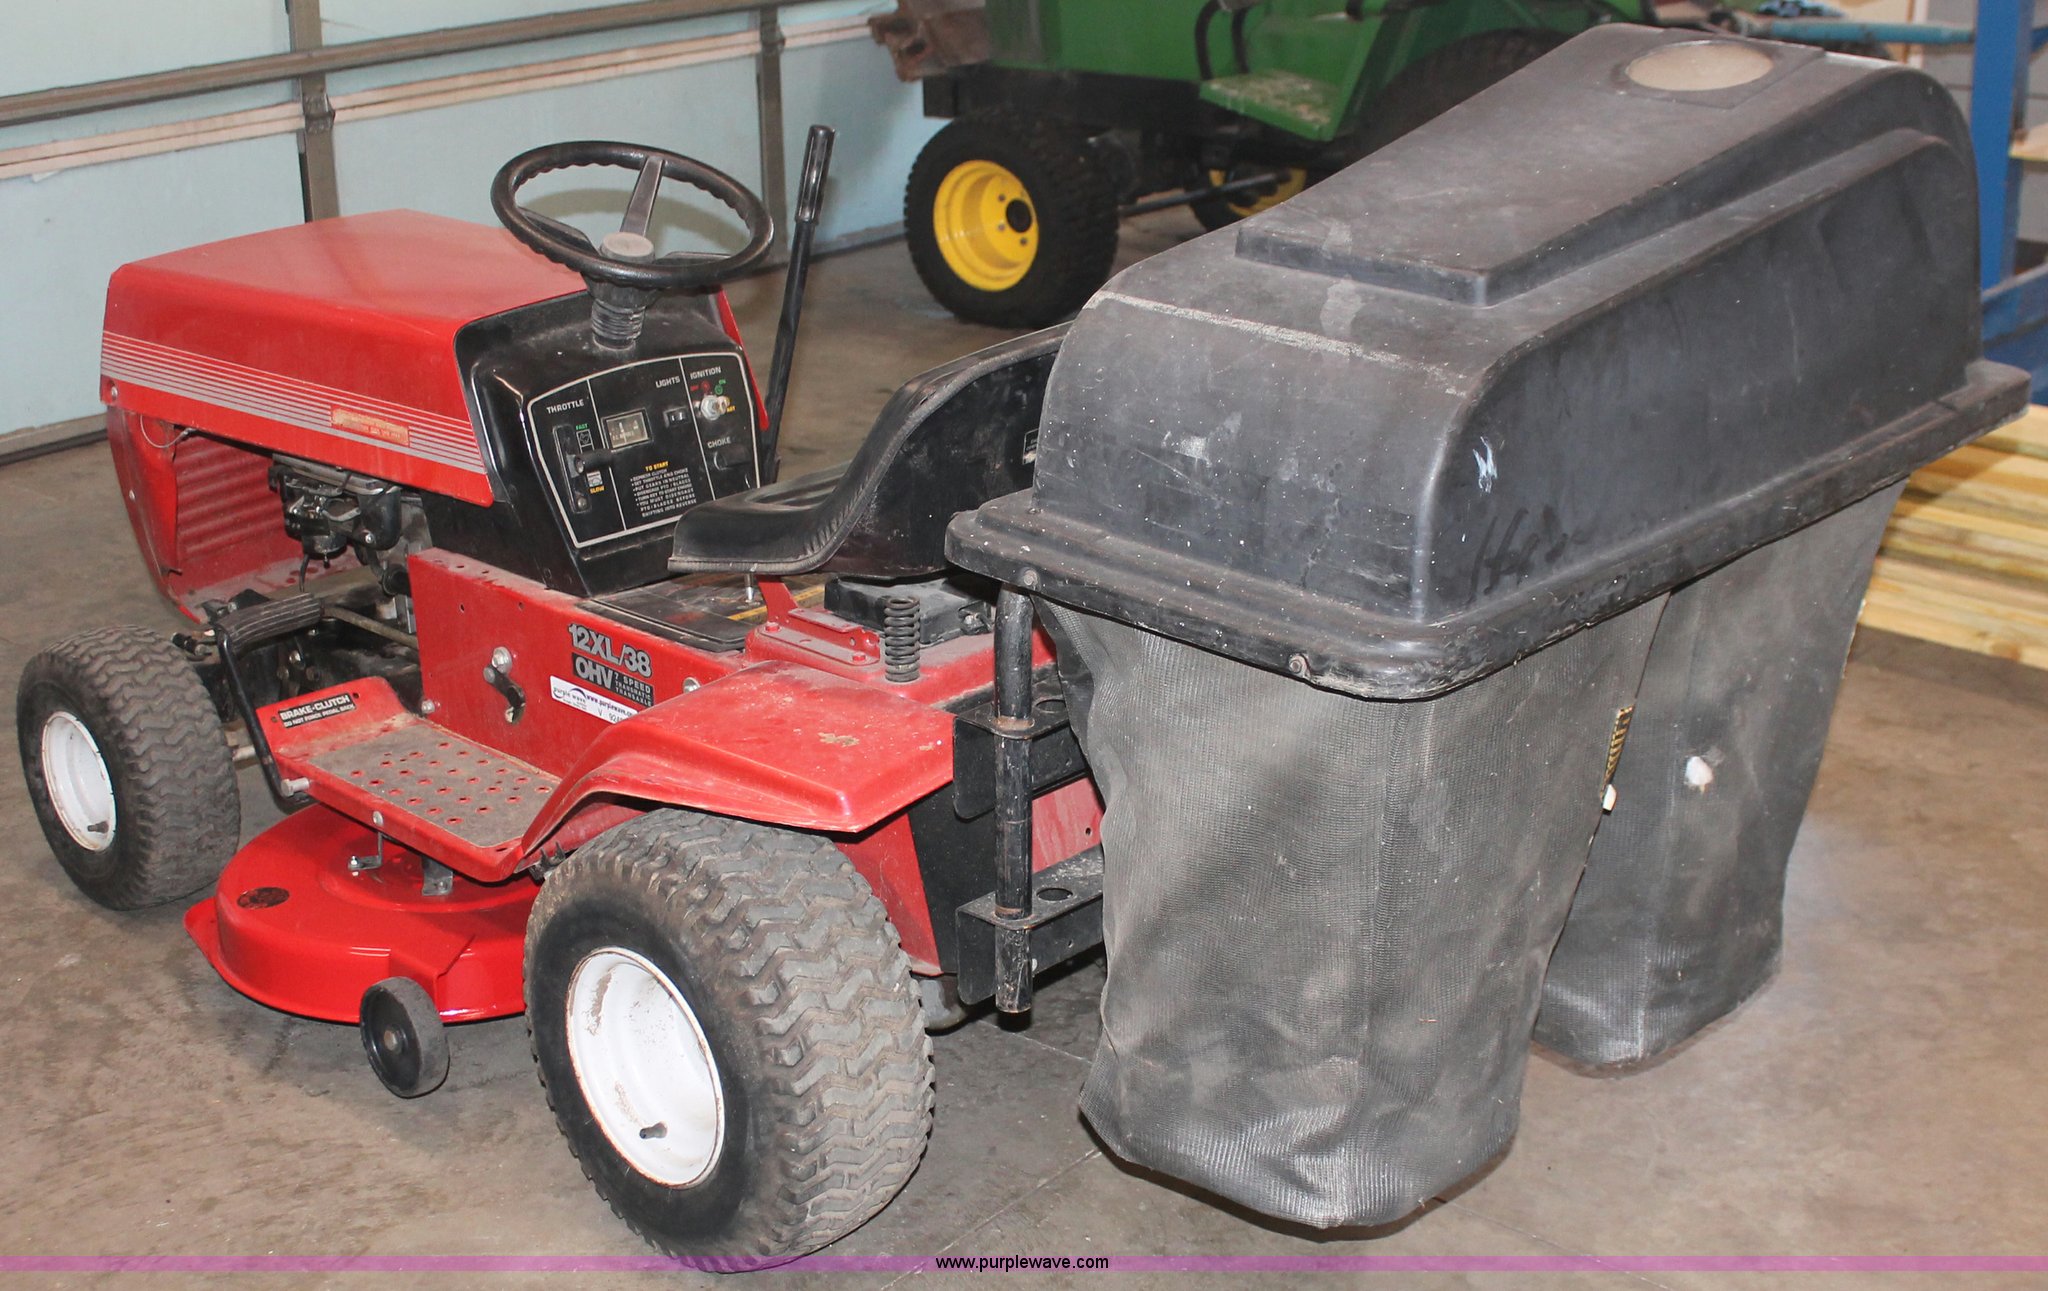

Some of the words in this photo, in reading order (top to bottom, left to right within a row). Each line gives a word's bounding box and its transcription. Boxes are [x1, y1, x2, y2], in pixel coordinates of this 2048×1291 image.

[690, 366, 721, 379] IGNITION
[656, 376, 680, 388] LIGHTS
[546, 399, 584, 414] THROTTLE
[707, 436, 731, 448] CHOKE
[653, 461, 669, 470] START
[568, 624, 652, 678] 12XL/38
[576, 656, 613, 689] OHV
[623, 676, 650, 693] SPEED
[616, 687, 651, 706] TRANSAXLE
[304, 713, 322, 721] FORCE
